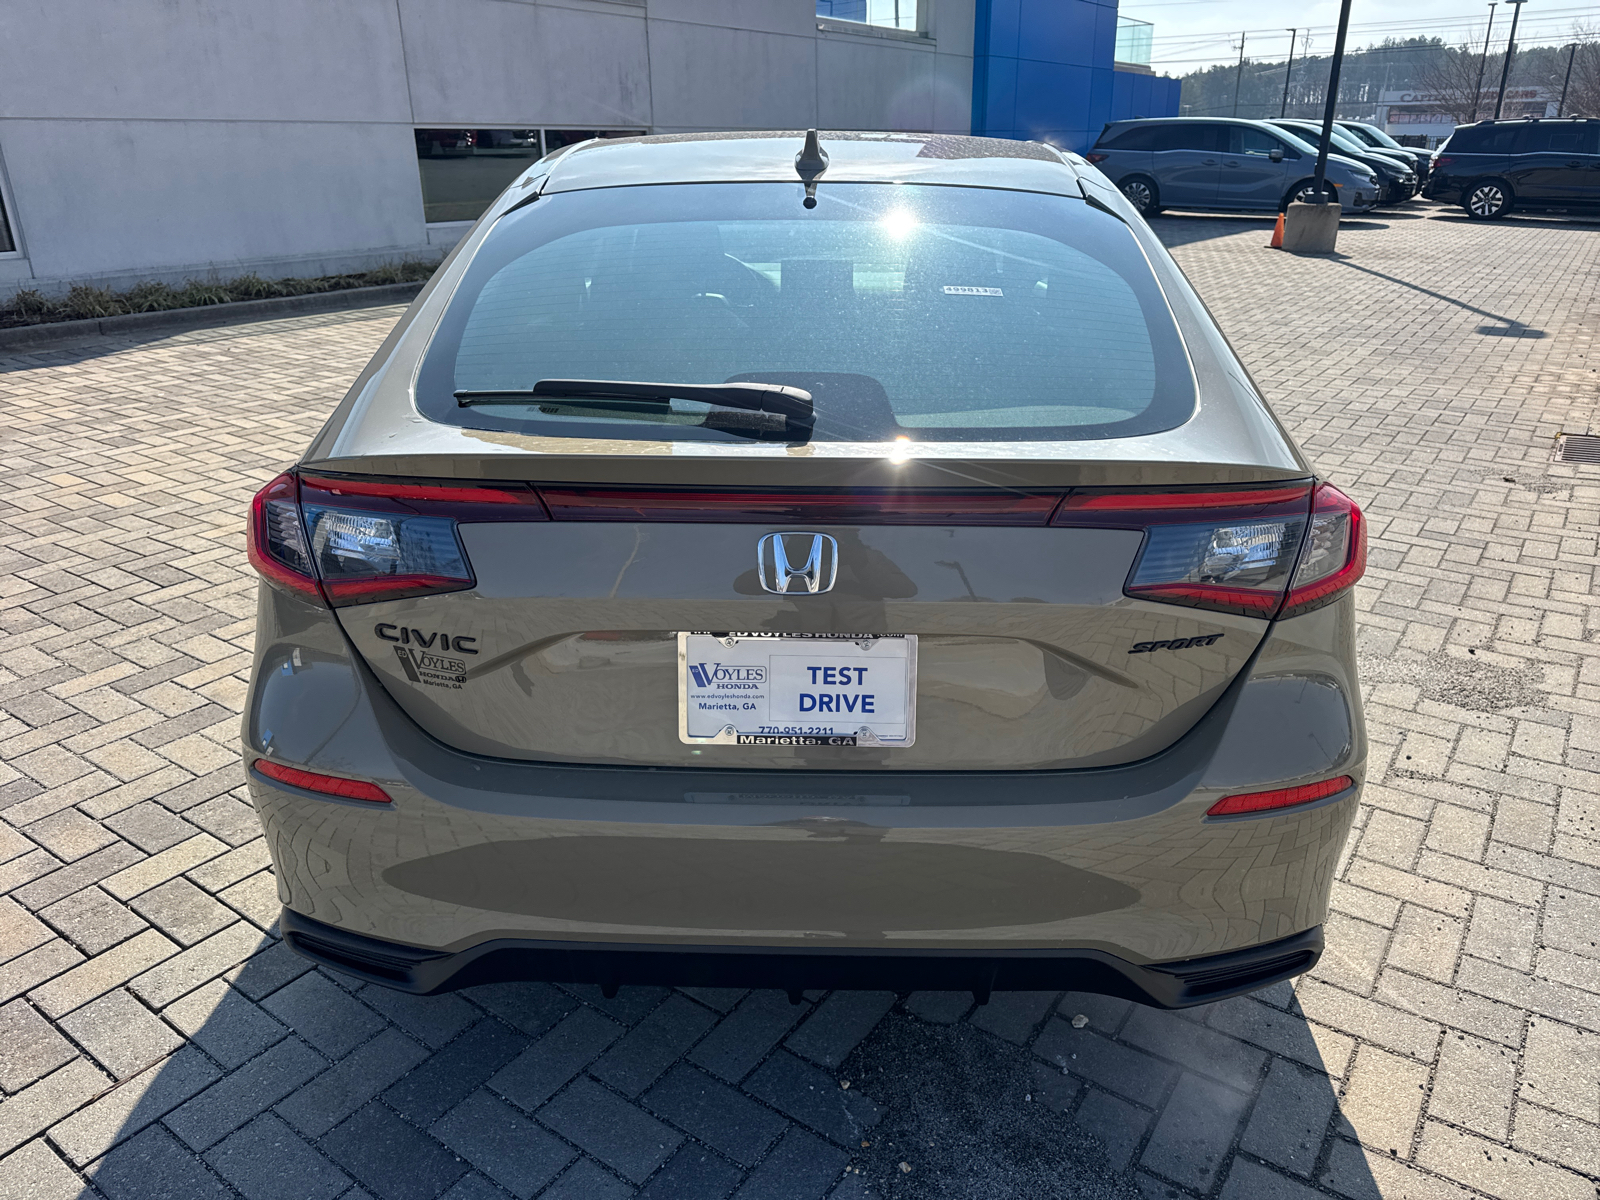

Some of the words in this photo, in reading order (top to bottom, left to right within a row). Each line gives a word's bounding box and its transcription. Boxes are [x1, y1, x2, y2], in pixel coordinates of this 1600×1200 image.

[374, 623, 479, 655] CIVIC
[1127, 633, 1225, 654] SPORT
[419, 671, 456, 682] HONDA
[698, 662, 764, 685] VOYLES
[807, 666, 868, 686] TEST
[698, 703, 740, 711] Marietta,
[742, 703, 757, 711] GA
[799, 693, 875, 714] DRIVE
[758, 726, 834, 735] 770-951-2211
[740, 736, 821, 745] Marietta,
[828, 737, 854, 746] GA
